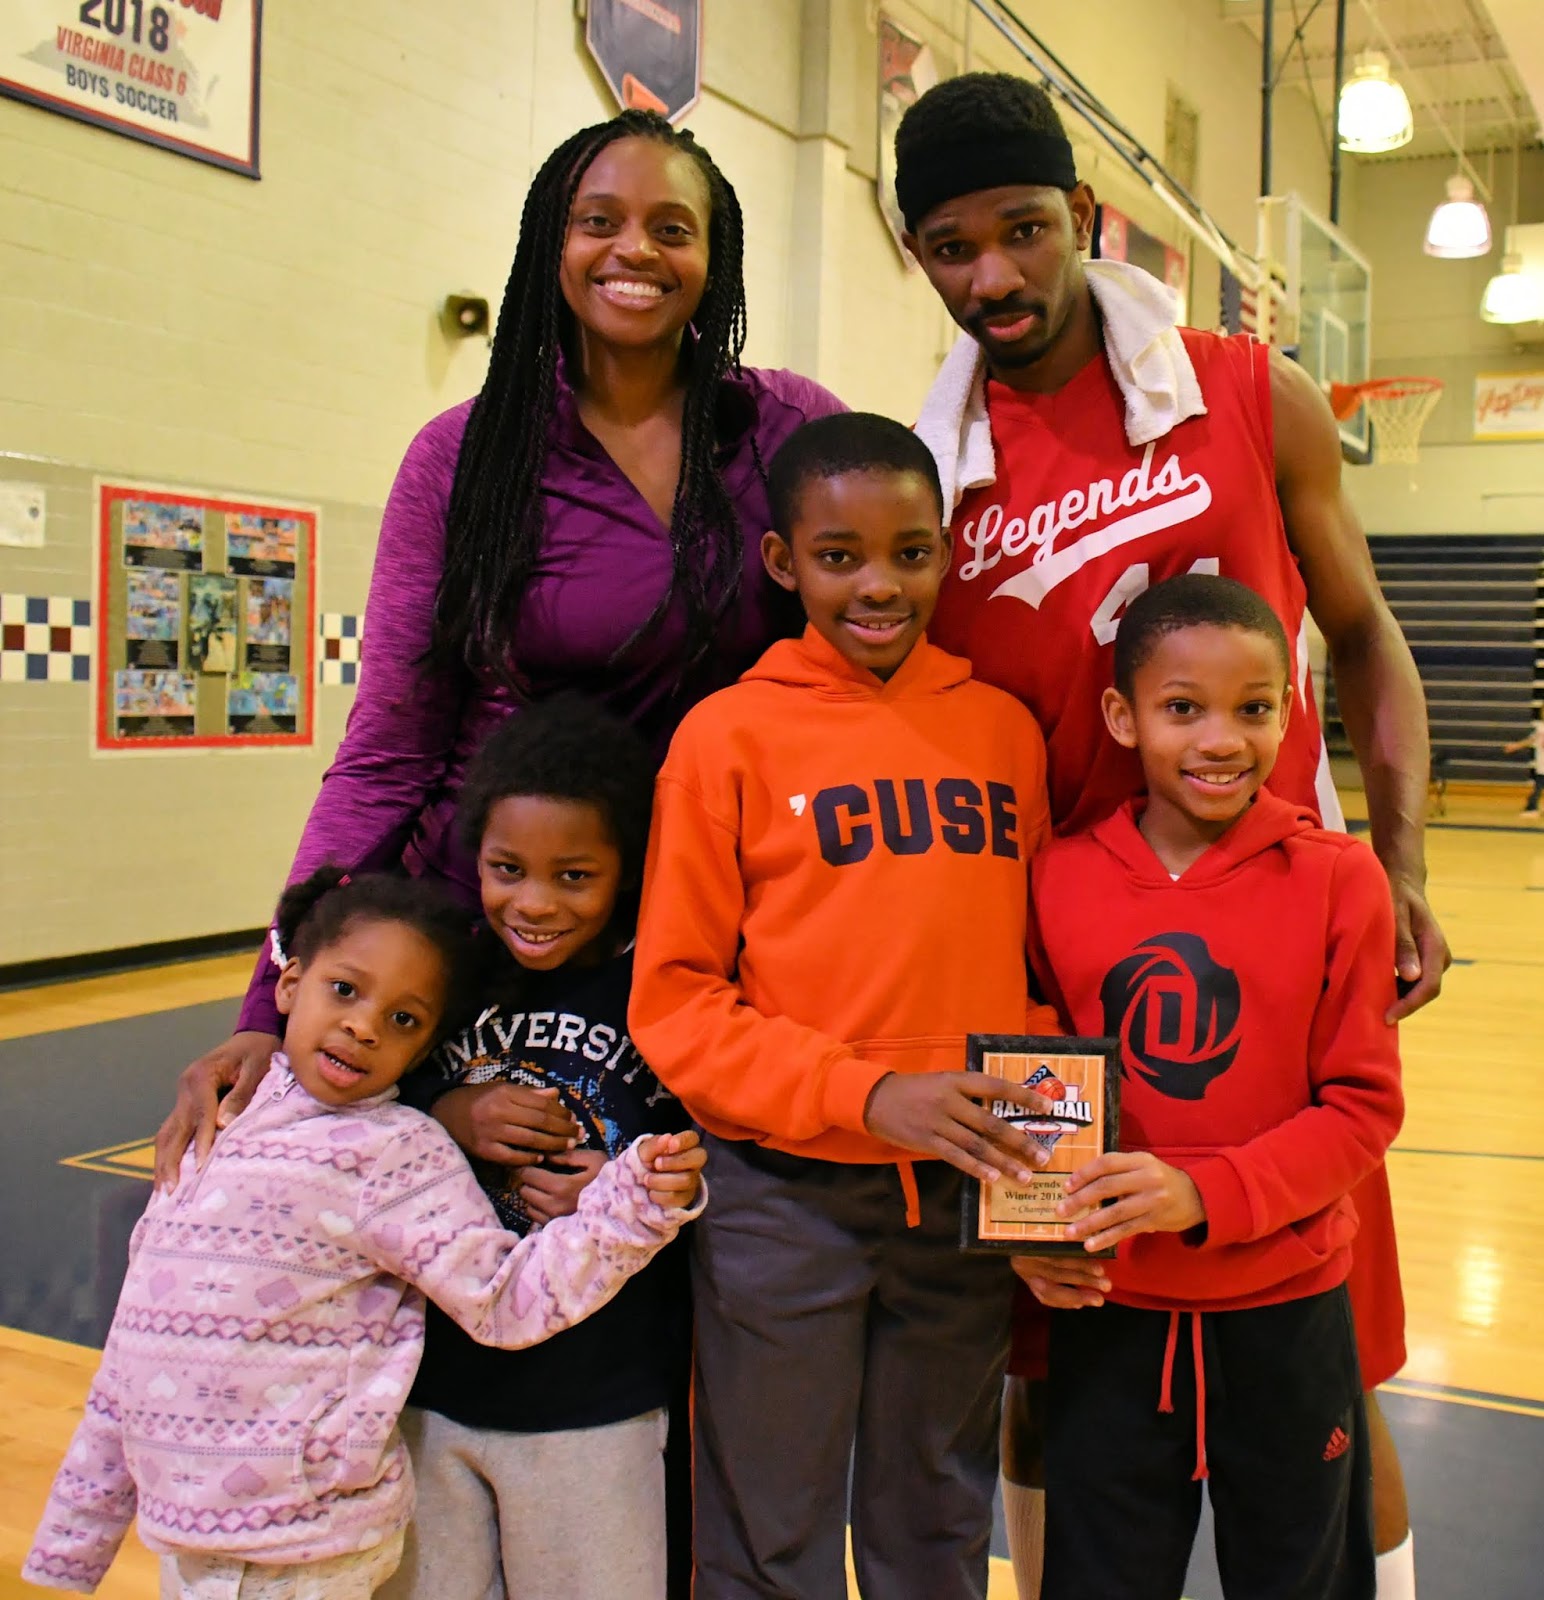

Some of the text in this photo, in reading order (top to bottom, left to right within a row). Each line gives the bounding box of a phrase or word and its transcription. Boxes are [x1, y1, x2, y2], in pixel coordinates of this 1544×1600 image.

[79, 0, 169, 52] 2018
[56, 26, 188, 97] VIRGINIA CLASS 6
[66, 63, 178, 122] BOYS SOCCER
[959, 441, 1183, 581] Legends
[788, 777, 1020, 867] 'CUSE
[992, 1099, 1093, 1122] BASBALL
[1004, 1191, 1037, 1201] Winter
